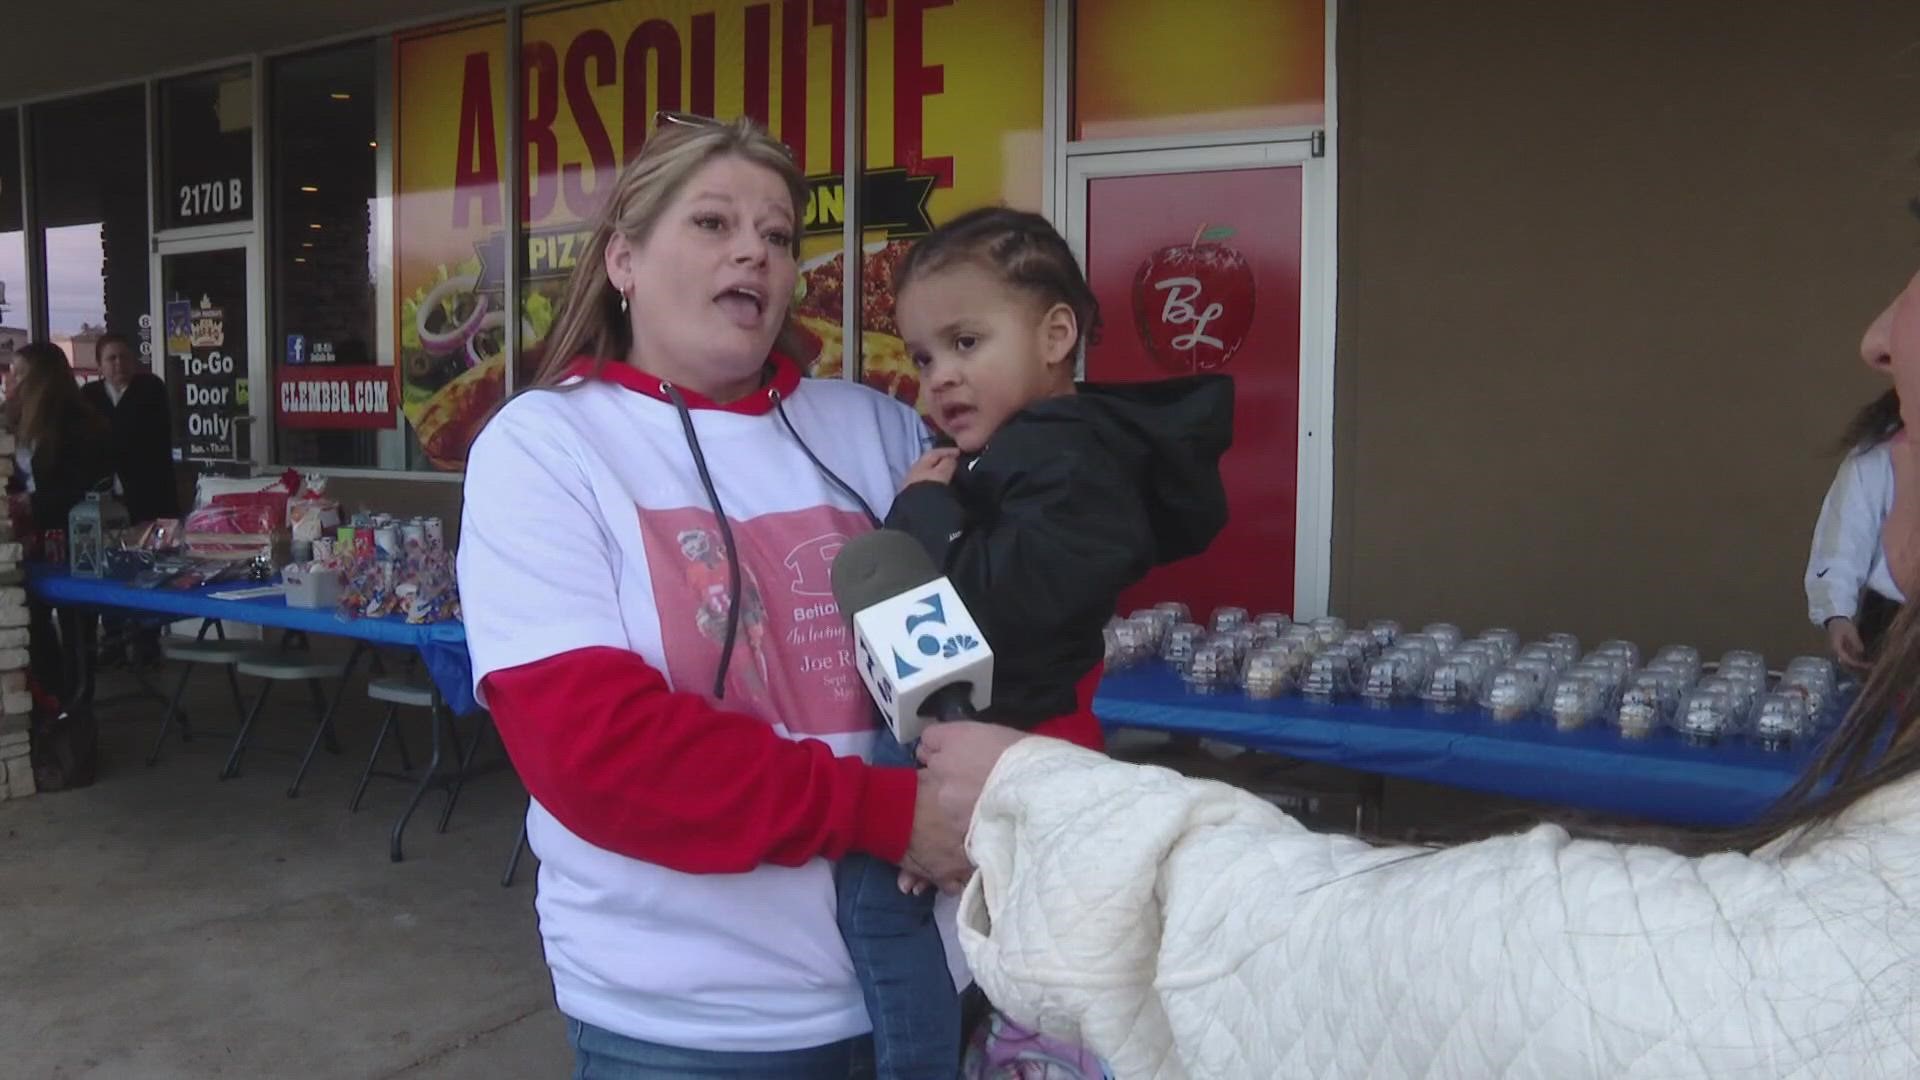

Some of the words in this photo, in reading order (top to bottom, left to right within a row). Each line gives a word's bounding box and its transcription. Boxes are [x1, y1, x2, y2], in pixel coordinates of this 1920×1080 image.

[180, 181, 223, 217] 2170
[229, 178, 242, 210] B
[181, 352, 234, 377] To-Go
[186, 384, 229, 406] Door
[281, 380, 389, 413] CLEMBBQ.COM
[188, 413, 230, 441] Only
[800, 656, 833, 672] Joe
